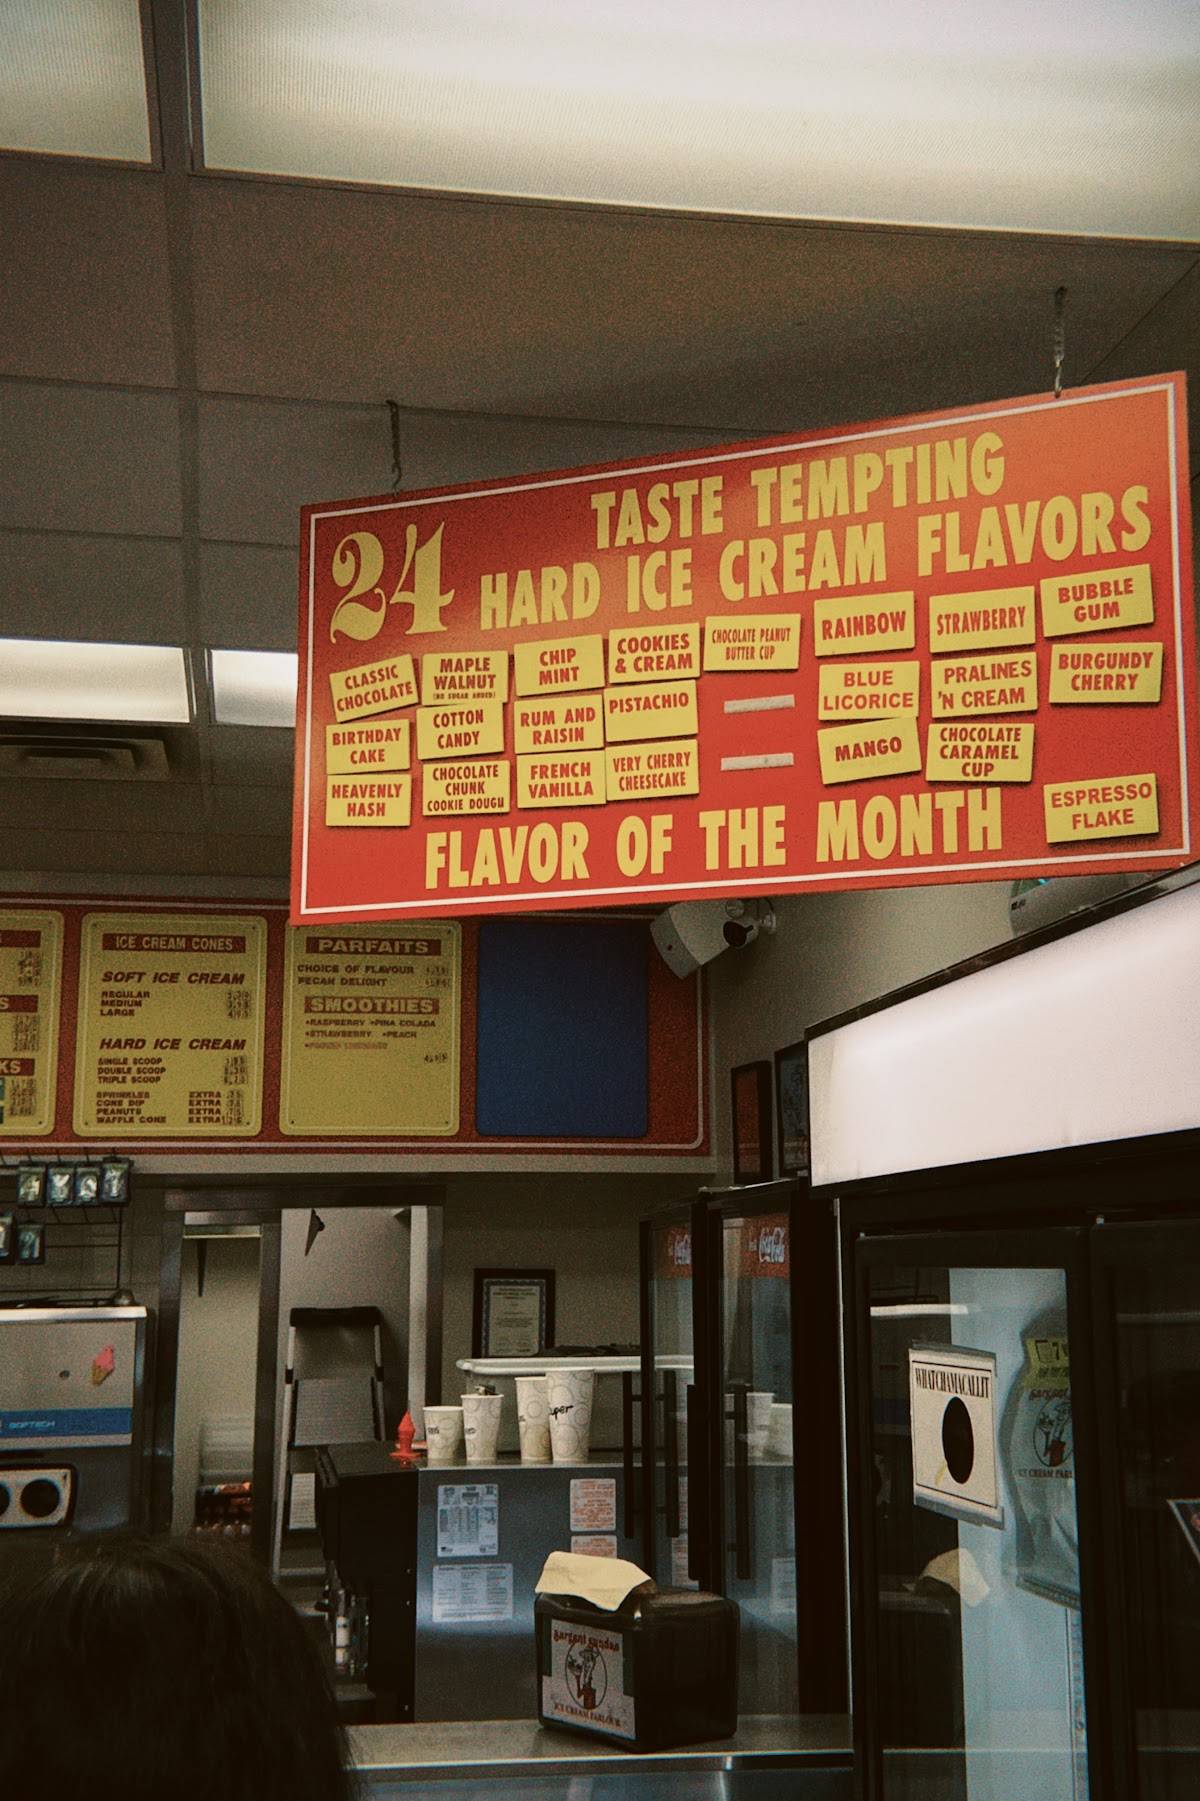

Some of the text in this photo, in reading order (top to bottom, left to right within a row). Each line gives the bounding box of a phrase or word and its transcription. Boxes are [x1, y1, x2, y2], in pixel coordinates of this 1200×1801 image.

[591, 432, 1005, 550] TASTE TEMPTING
[480, 485, 1151, 631] HARD ICE CREAM FLAVORS
[330, 521, 455, 644] 24
[1058, 578, 1134, 604] BUBBLE
[937, 606, 1026, 636] STRAWBERRY
[1073, 601, 1120, 623] GUM
[822, 610, 906, 641] RAINBOW
[617, 633, 690, 655] COOKIES
[712, 627, 791, 644] CHOCOLATE PEANUT
[539, 648, 577, 667] CHIP
[725, 645, 776, 661] BUTTER CUP
[1058, 651, 1154, 670] BURGUNDY
[440, 657, 491, 673] MAPLE
[615, 653, 693, 674] & CREAM
[944, 660, 1032, 684] PRALINES
[344, 665, 399, 690] CLASSIC
[434, 674, 497, 690] WALNUT
[539, 666, 579, 686] MINT
[844, 670, 894, 688] BLUE
[1071, 673, 1139, 691] CHERRY
[336, 681, 414, 712] CHOCOLATE
[609, 692, 689, 714] PISTACHIO
[823, 692, 914, 711] LICORICE
[961, 687, 1025, 708] CREAM
[433, 709, 484, 728] COTTON
[520, 707, 596, 727] RUM AND
[332, 728, 401, 746] BIRTHDAY
[437, 731, 480, 749] CANDY
[532, 727, 585, 745] RAISIN
[940, 727, 1022, 742] CHOCOLATE
[350, 749, 385, 764] CAKE
[835, 736, 903, 762] MANGO
[939, 745, 1019, 760] CARAMEL
[530, 762, 591, 780] FRENCH
[613, 751, 691, 773] VERY CHERRY
[961, 762, 995, 777] CUP
[432, 765, 499, 781] CHOCOLATE
[619, 771, 686, 792] CHEESECAKE
[331, 783, 403, 799] HEAVENLY
[445, 781, 485, 796] CHUNK
[528, 781, 594, 799] VANILLA
[1051, 782, 1152, 808] ESPRESSO
[347, 803, 386, 817] HASH
[427, 797, 504, 812] COOKIE DOUGH
[1071, 808, 1135, 830] FLAKE
[426, 787, 1002, 890] FLAVOR OF THE MONTH
[116, 935, 233, 951] ICE CREAM CONES
[318, 939, 429, 954] PARFAITS
[102, 971, 246, 985] SOFT ICE CREAM
[297, 965, 414, 975] CHOICE OF FLAVOUR
[298, 977, 388, 987] PECAN DELIGHT
[100, 1000, 142, 1008] MEDIUM
[101, 991, 151, 999] REGULAR
[100, 1008, 135, 1016] LARGE
[310, 999, 434, 1013] SMOOTHIES
[99, 1038, 247, 1051] HARD ICE CREAM
[98, 1057, 128, 1065] SINGLE
[132, 1057, 162, 1065] SCOOP
[97, 1076, 127, 1084] TRIPLE
[131, 1076, 161, 1084] SCOOP
[96, 1116, 134, 1124] WAFFLE
[139, 1116, 166, 1124] CONE
[188, 1116, 221, 1124] EXTRA
[915, 1367, 989, 1399] WHATCHAMACALLIT
